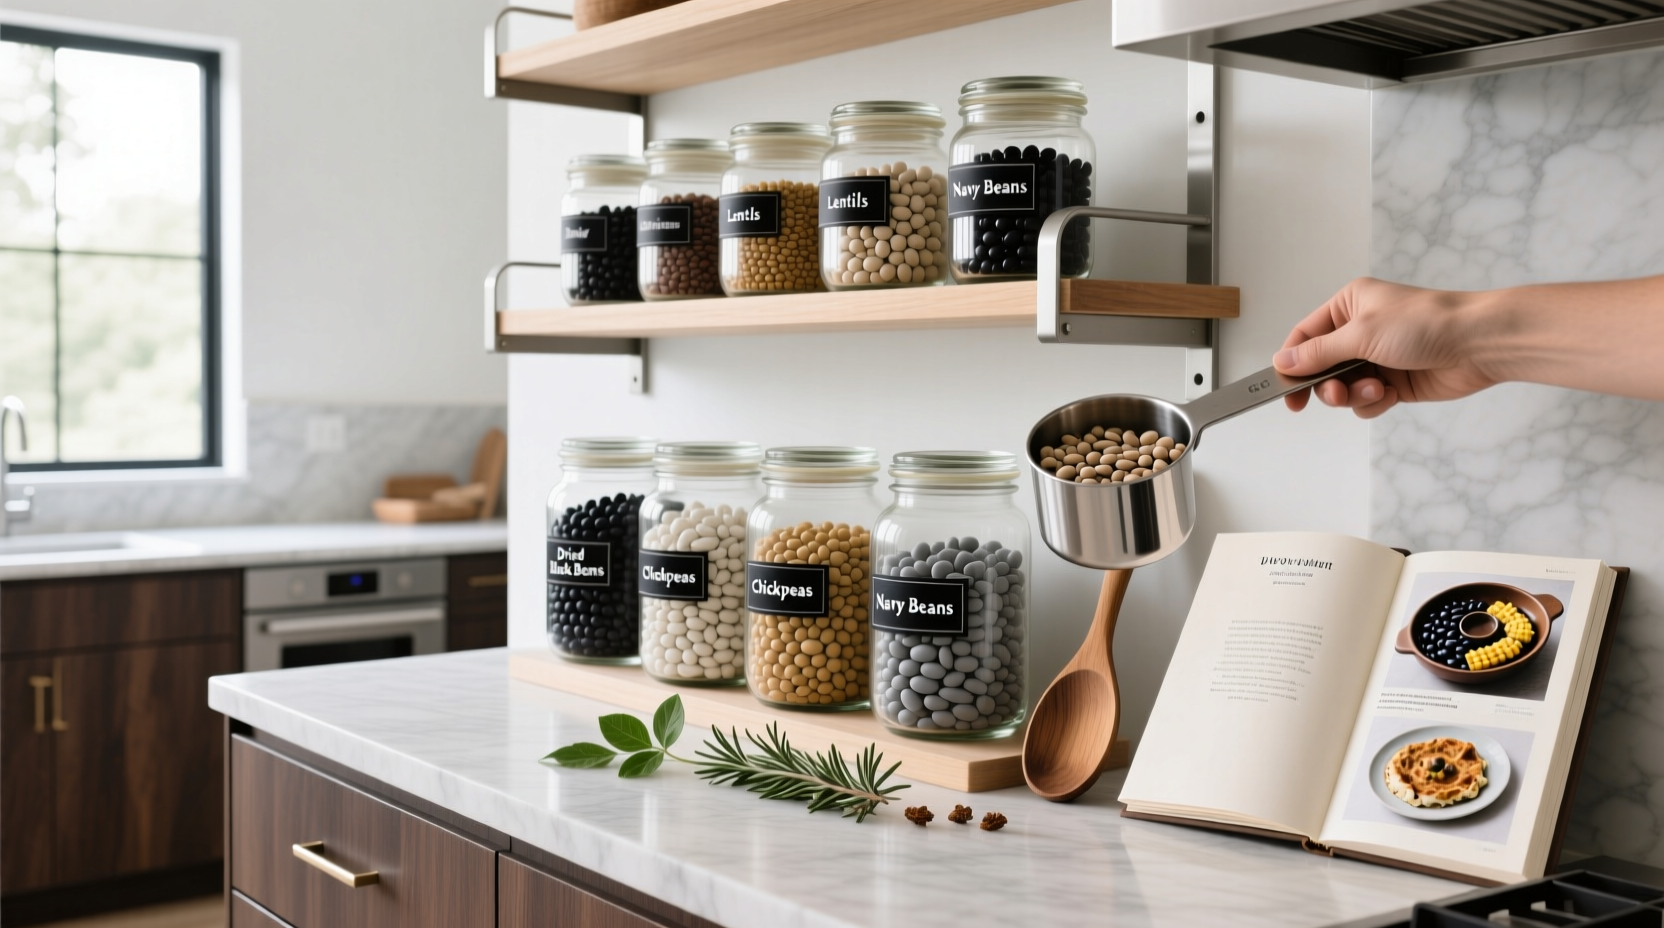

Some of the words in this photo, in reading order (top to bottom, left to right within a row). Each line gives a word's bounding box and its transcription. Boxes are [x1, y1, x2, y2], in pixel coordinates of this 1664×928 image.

[953, 181, 980, 200] Navy
[984, 179, 1028, 195] Beans
[828, 192, 868, 209] Lentils
[752, 579, 812, 601] Chickpeas
[909, 597, 953, 615] Beans
